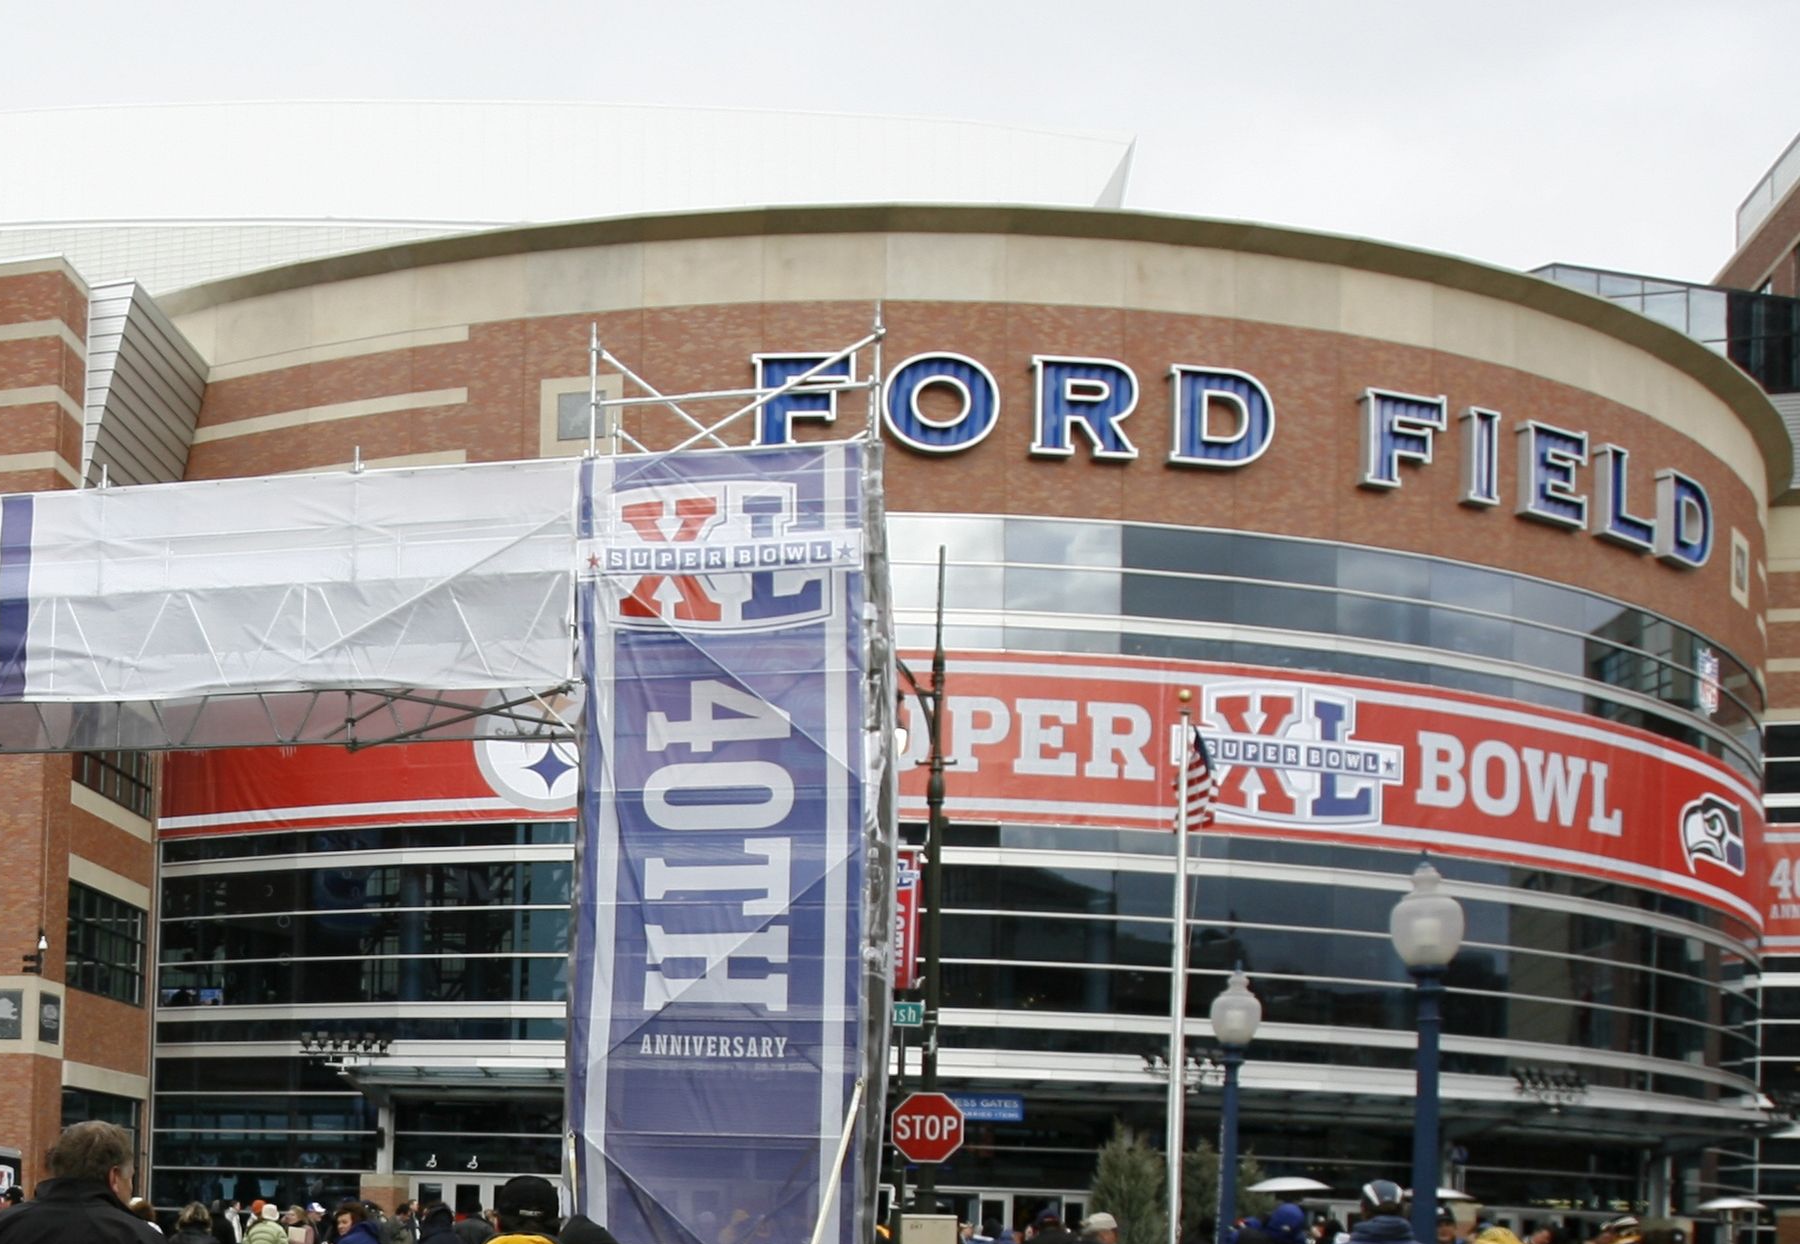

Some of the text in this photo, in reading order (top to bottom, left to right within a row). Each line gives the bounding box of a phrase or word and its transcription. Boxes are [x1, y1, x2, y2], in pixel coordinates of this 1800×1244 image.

[752, 350, 1714, 568] FORD FIELD
[609, 543, 830, 569] SUPER BOWL
[619, 494, 823, 622] XL
[1212, 694, 1374, 817] XL
[1308, 750, 1379, 772] BOWL
[1415, 729, 1623, 837] BOWL
[642, 678, 795, 1013] 40TH
[639, 1033, 788, 1058] ANNIVERSARY
[896, 1114, 958, 1141] STOP
